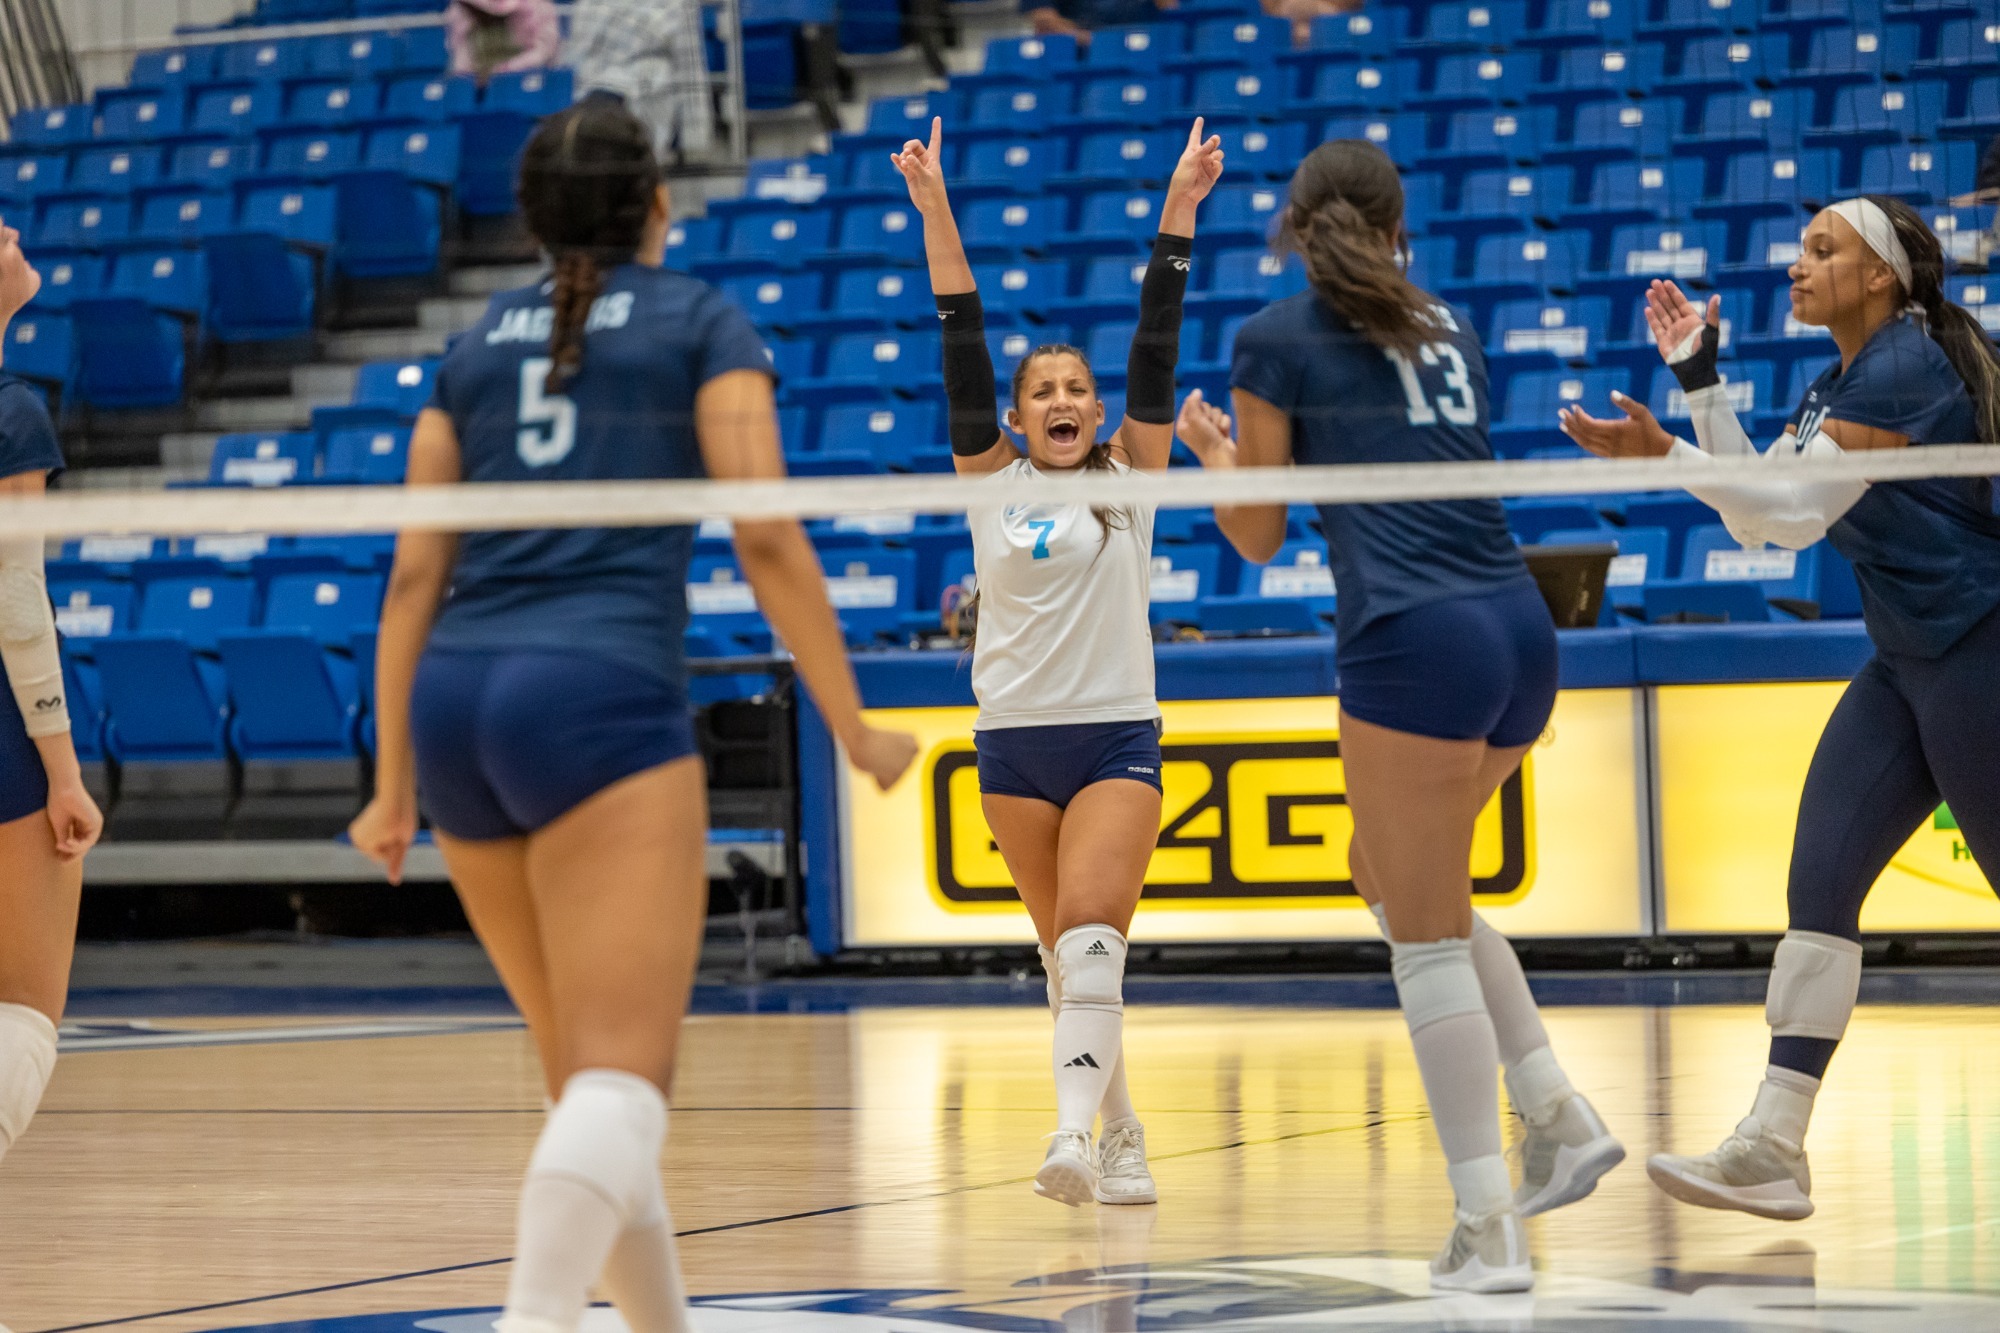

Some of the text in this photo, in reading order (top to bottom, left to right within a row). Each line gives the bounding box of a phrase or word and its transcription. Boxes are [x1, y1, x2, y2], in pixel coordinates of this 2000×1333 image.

[485, 291, 635, 346] JAGRS
[1384, 342, 1477, 426] 13
[516, 357, 577, 468] 5
[1028, 519, 1056, 560] 7
[1127, 766, 1154, 774] adidas
